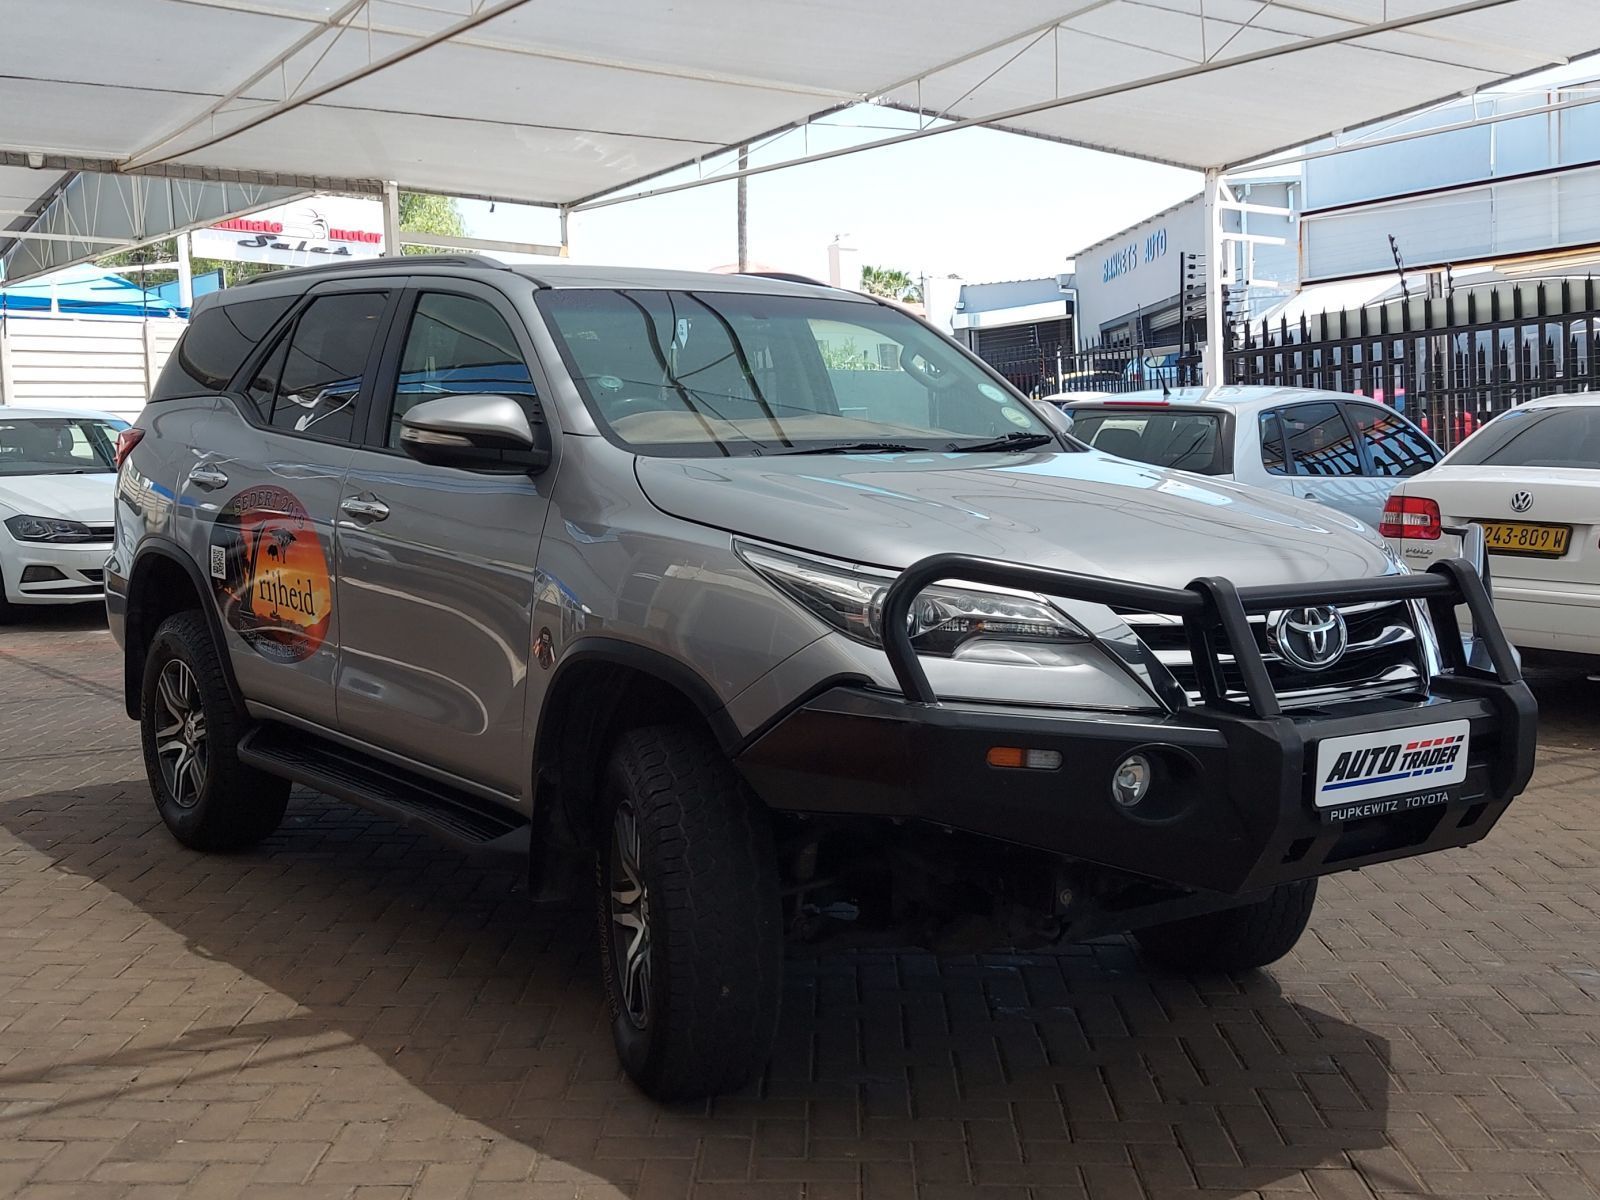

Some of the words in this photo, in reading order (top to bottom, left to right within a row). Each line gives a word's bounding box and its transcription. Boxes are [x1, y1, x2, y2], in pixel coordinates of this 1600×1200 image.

[237, 233, 352, 256] Sales
[330, 228, 383, 244] motor
[1145, 228, 1167, 264] AUTO
[1485, 526, 1549, 547] 243-809
[1553, 530, 1565, 549] W
[1325, 744, 1402, 783] AUTO
[1400, 745, 1461, 772] TRADER
[1330, 800, 1398, 821] PUPKEWITZ
[1406, 791, 1449, 808] TOYOTA
